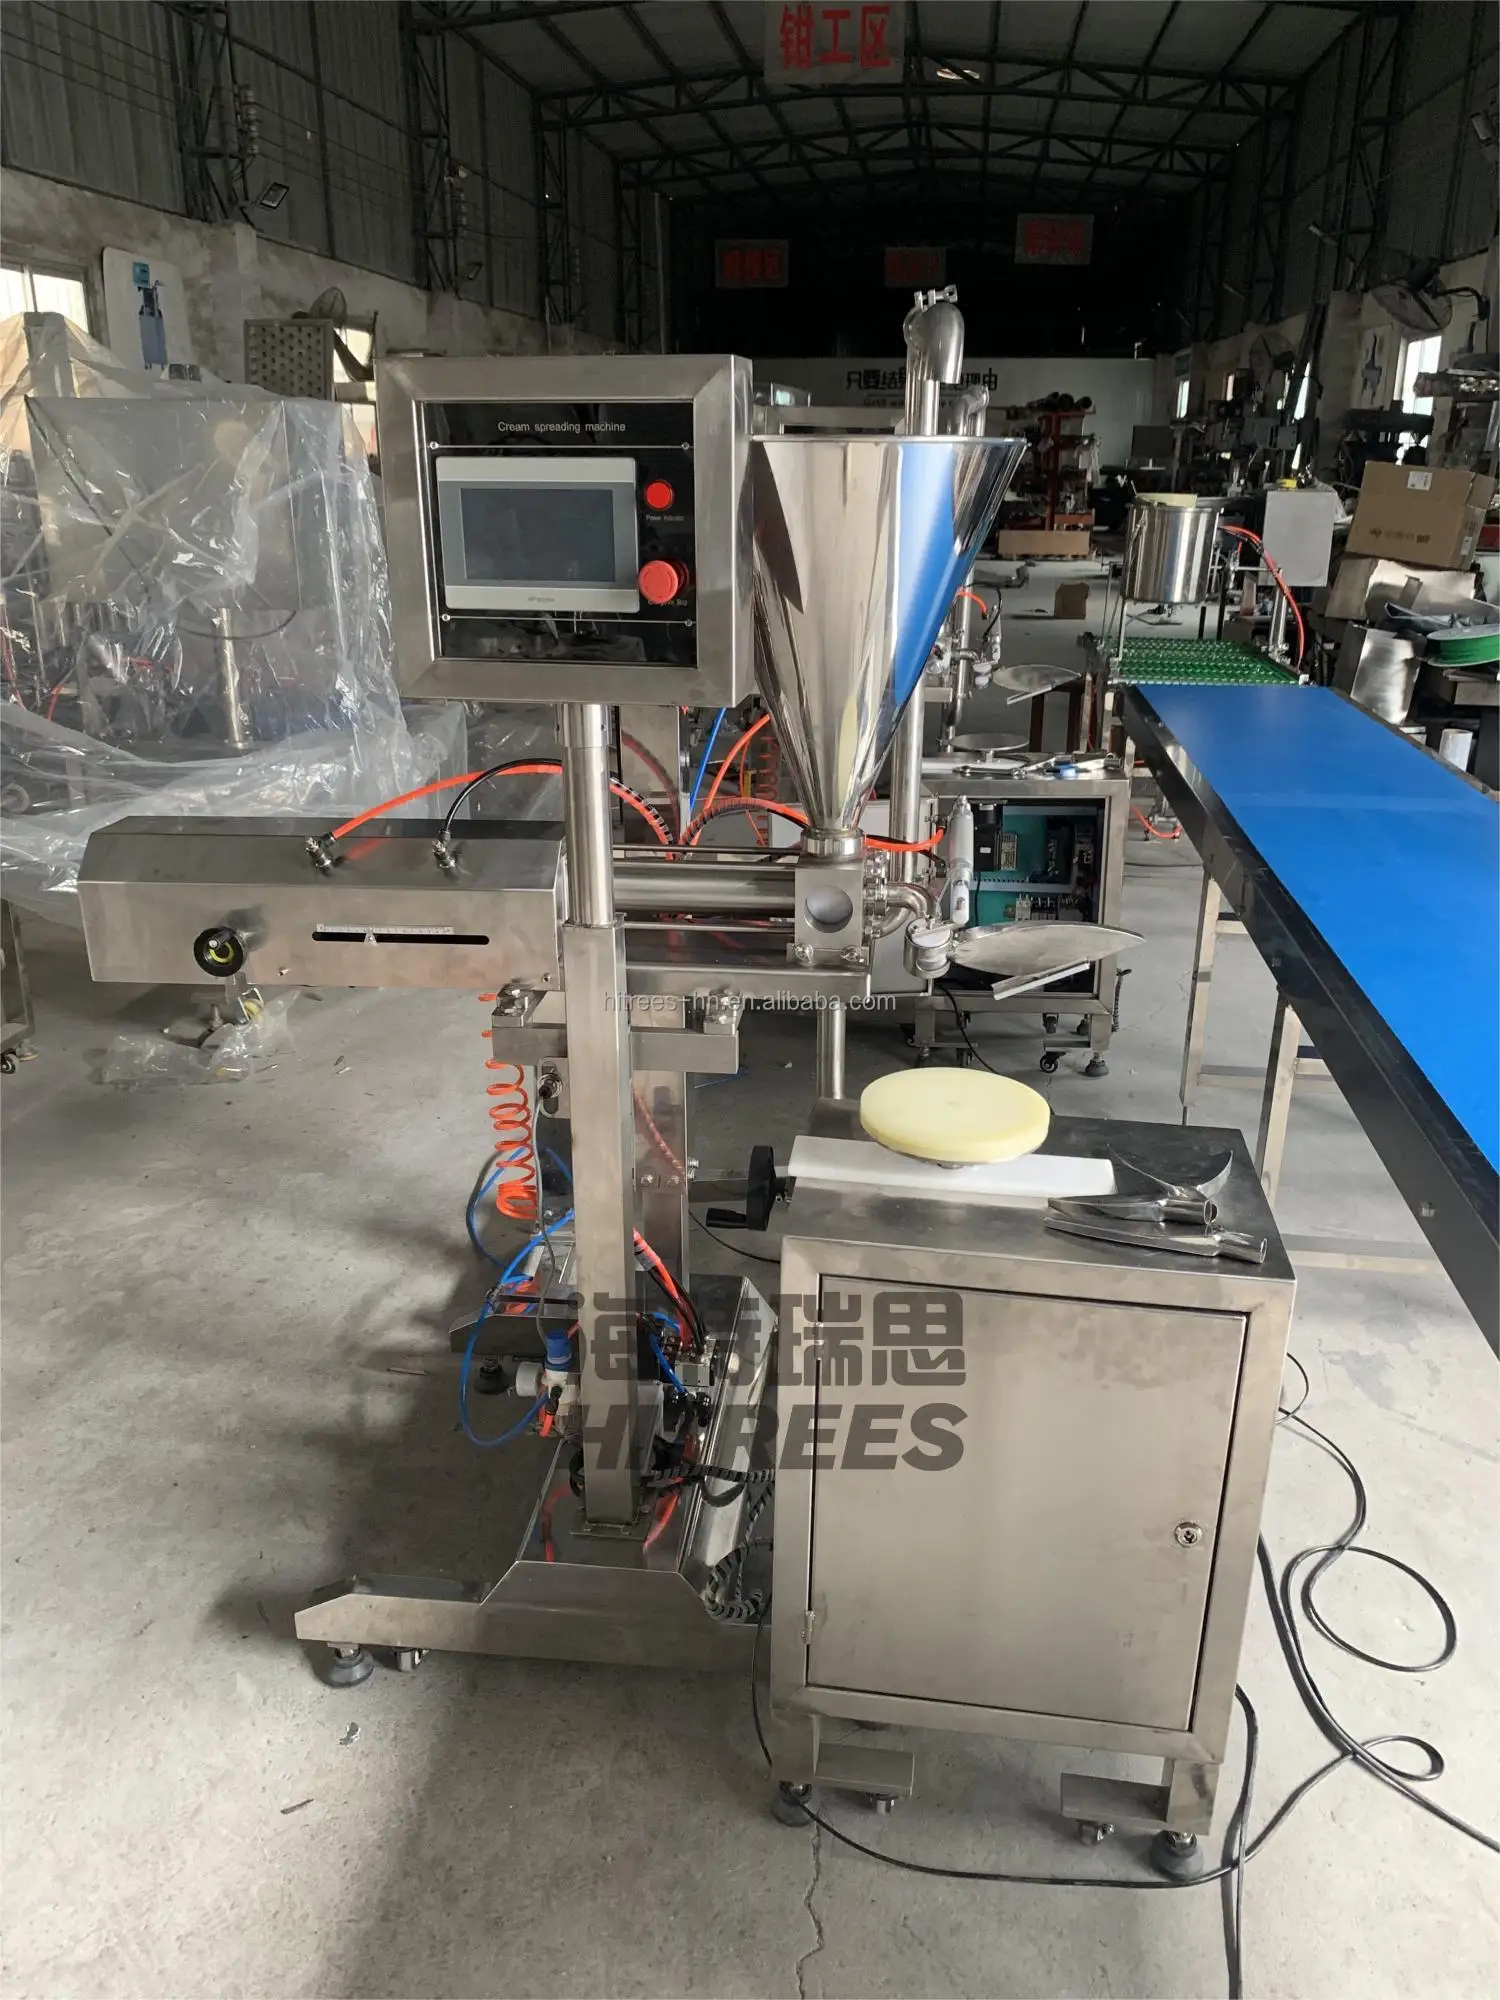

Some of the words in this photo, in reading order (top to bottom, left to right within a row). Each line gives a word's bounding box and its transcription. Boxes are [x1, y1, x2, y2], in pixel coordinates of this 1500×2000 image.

[780, 4, 892, 70] 钳工区
[497, 421, 530, 432] Cream
[534, 421, 581, 434] spreading
[585, 421, 626, 432] machine
